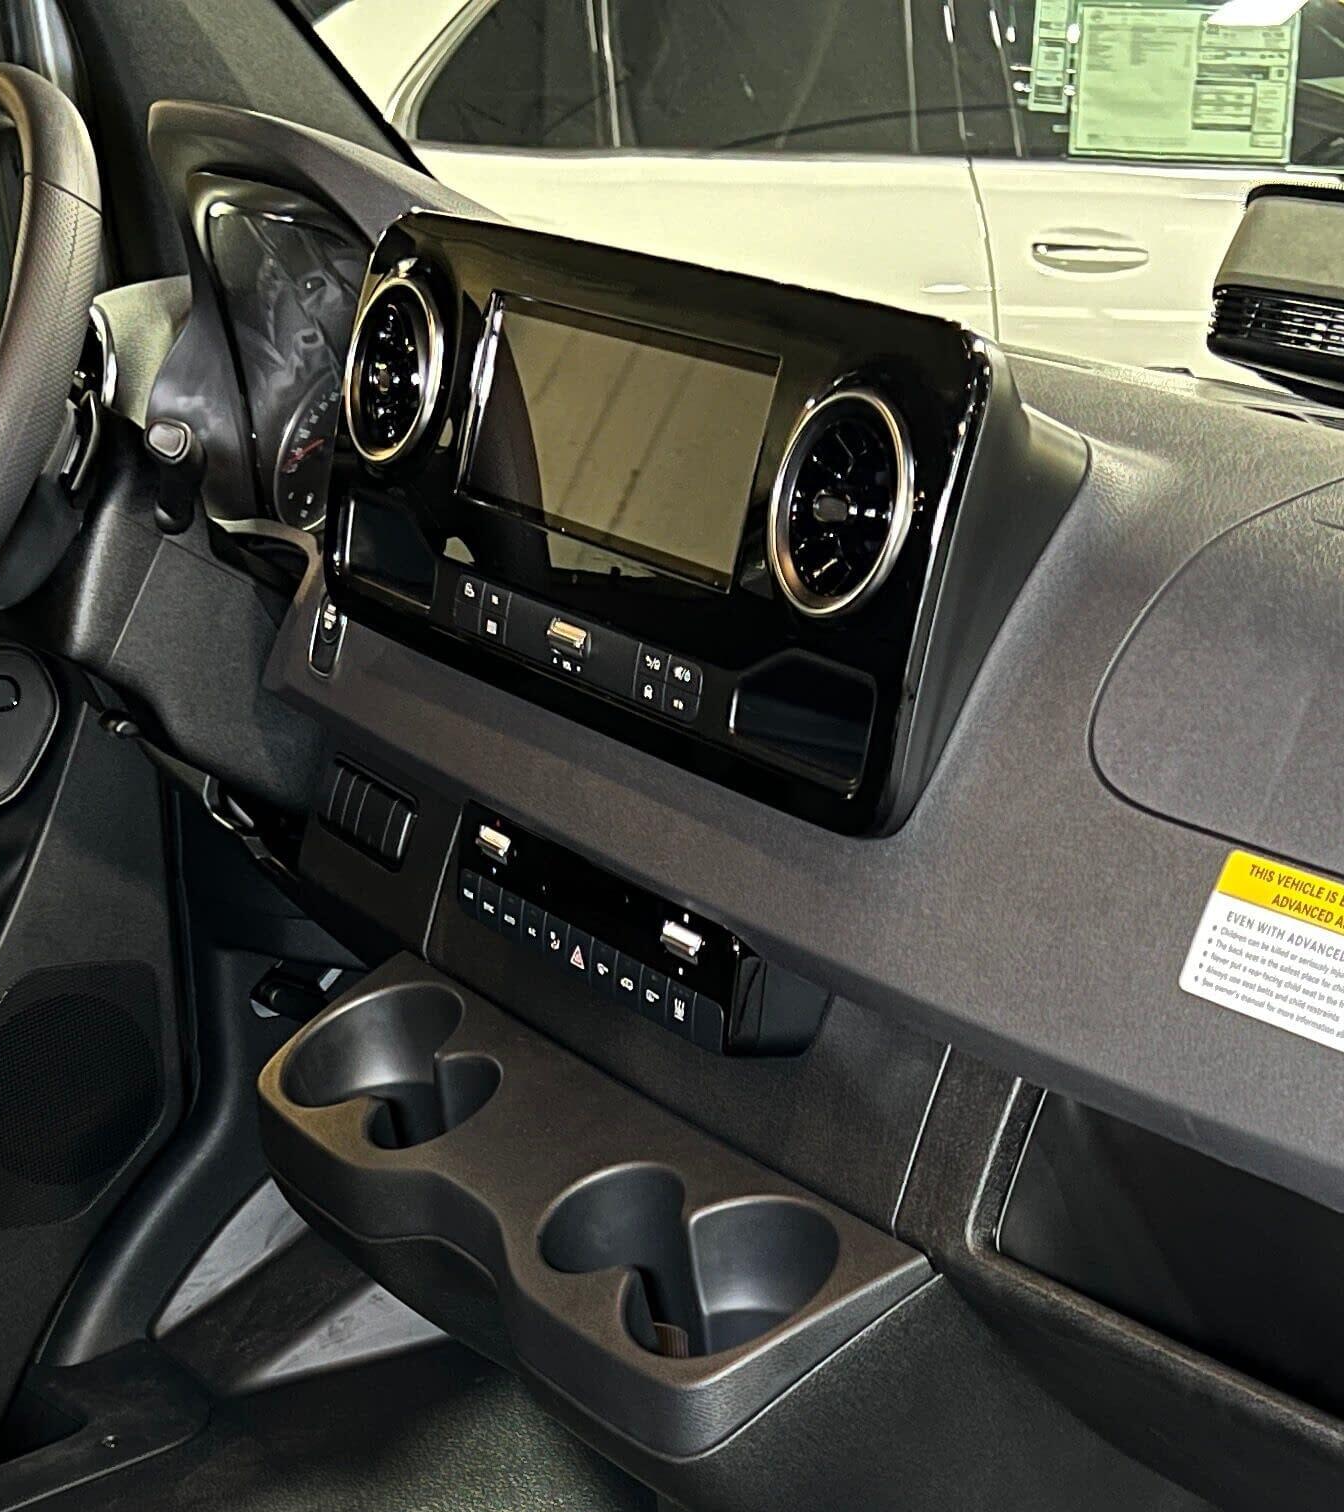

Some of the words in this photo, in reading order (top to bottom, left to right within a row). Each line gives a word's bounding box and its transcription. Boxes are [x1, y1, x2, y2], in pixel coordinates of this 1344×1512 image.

[1250, 864, 1275, 883] THIS
[1277, 873, 1325, 899] VEHICLE
[1325, 890, 1339, 904] IS
[1271, 894, 1334, 923] ADVANCED
[1226, 910, 1256, 930] EVEN
[1257, 921, 1286, 941] WITH
